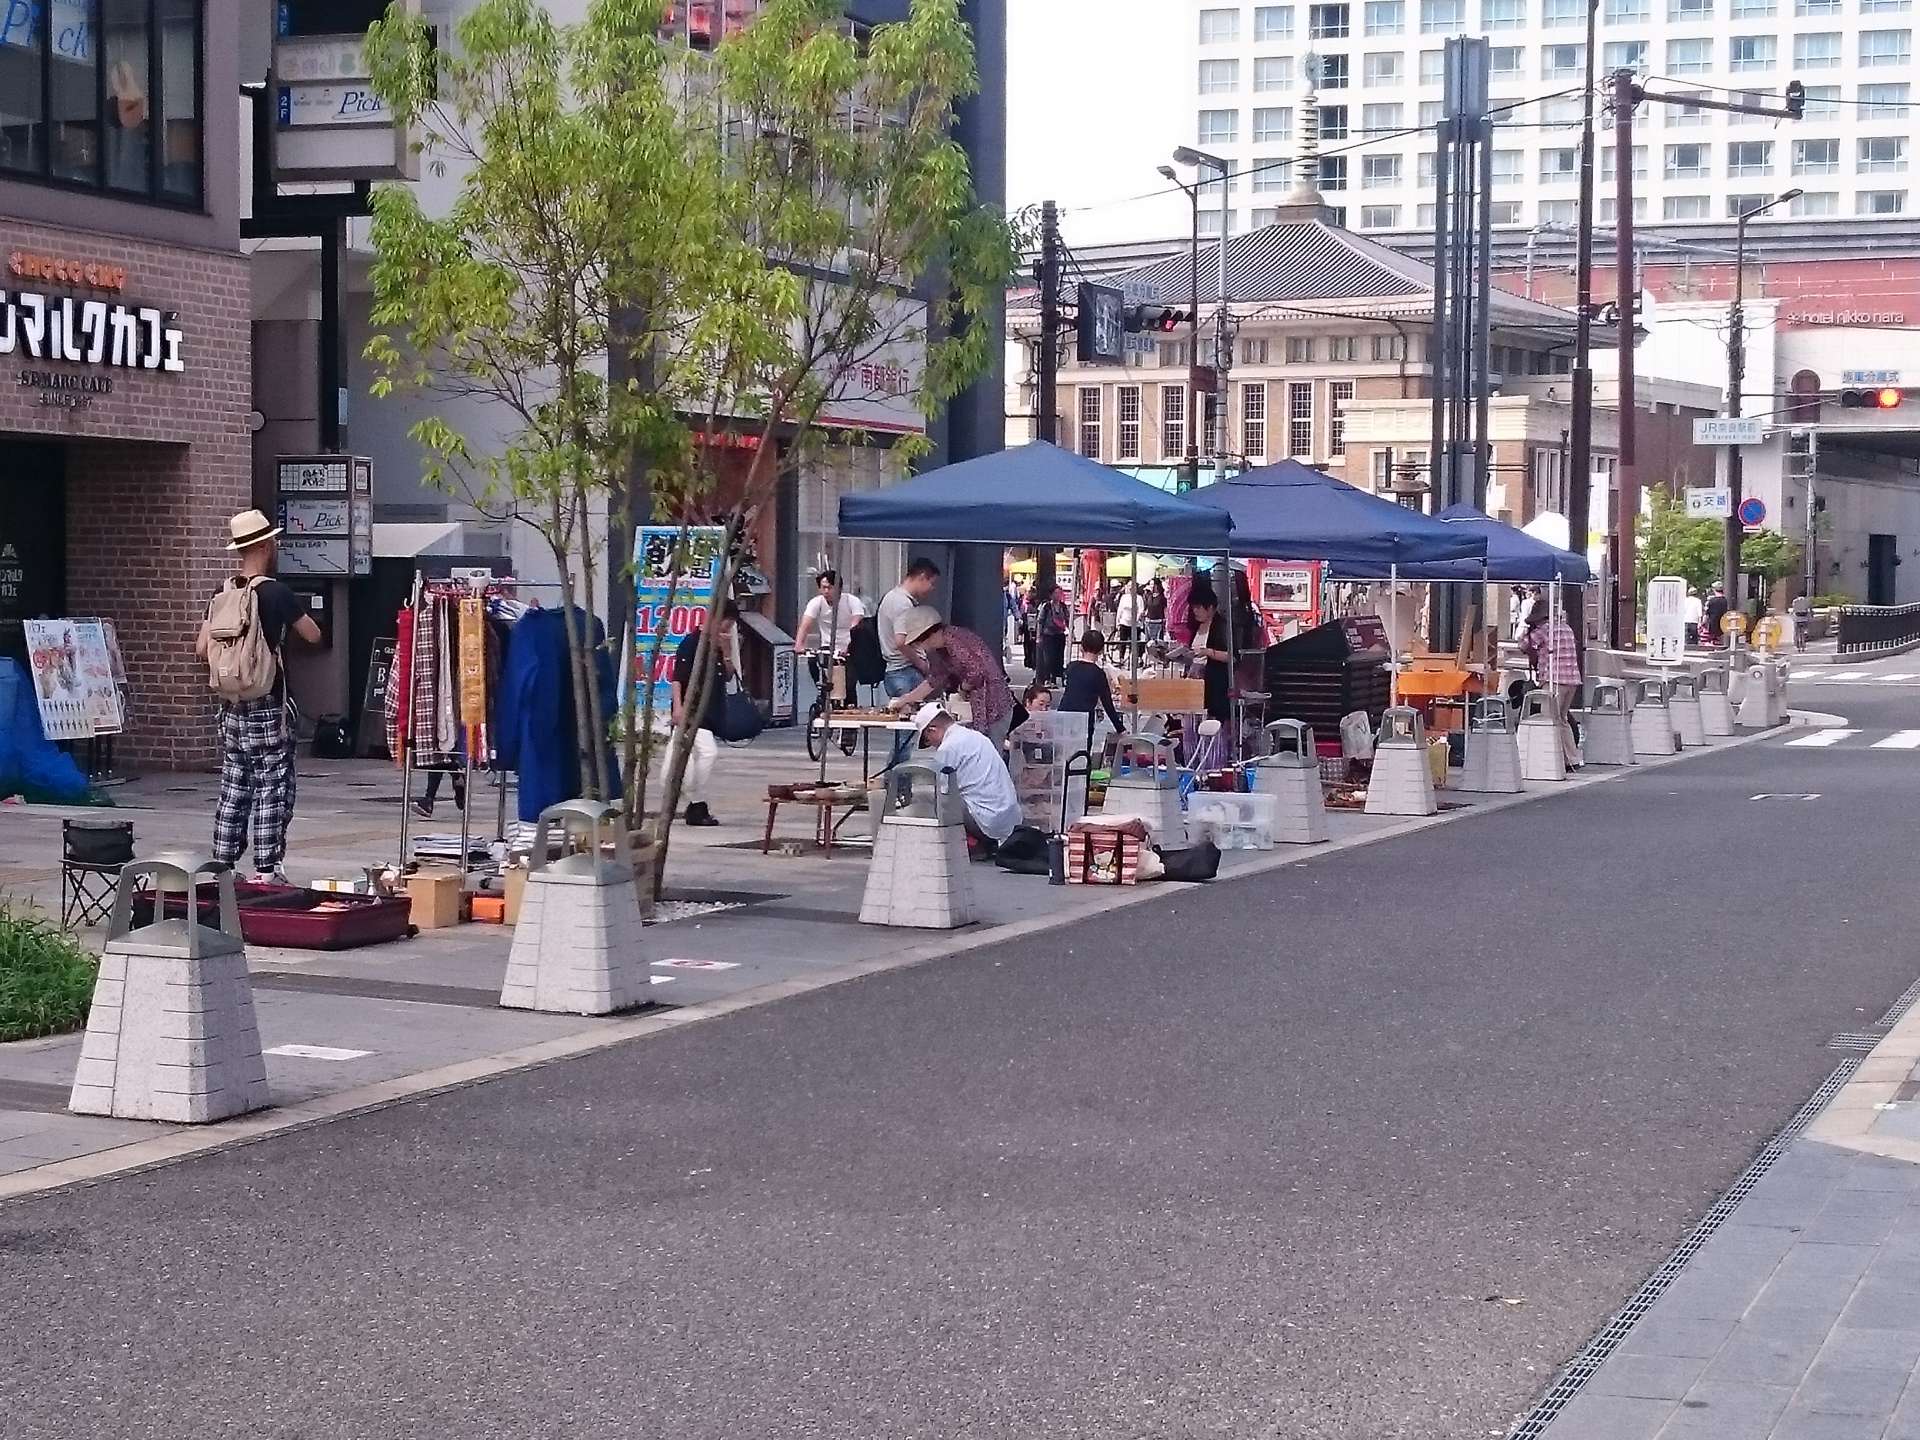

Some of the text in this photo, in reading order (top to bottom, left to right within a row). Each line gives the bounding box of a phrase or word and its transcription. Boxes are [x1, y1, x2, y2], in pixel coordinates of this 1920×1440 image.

[280, 96, 288, 119] 2F
[1802, 309, 1904, 324] hotel nikko nara
